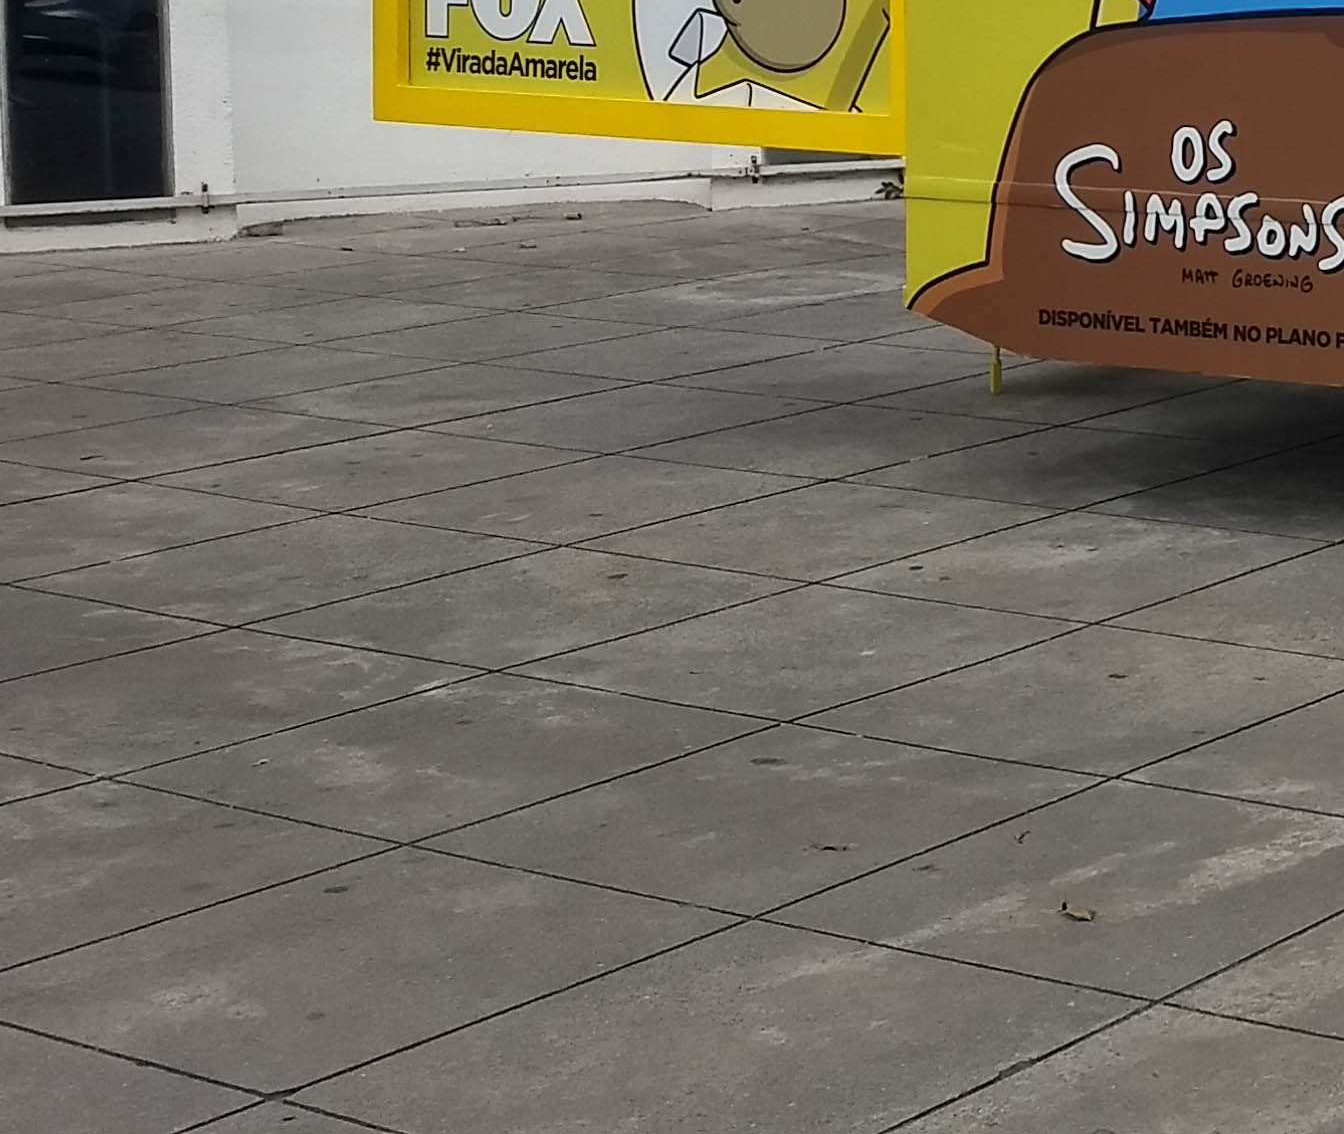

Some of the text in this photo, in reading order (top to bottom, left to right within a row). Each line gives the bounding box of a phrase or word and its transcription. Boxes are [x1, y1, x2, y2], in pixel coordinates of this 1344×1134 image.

[426, 47, 597, 81] #ViradaAmarela
[1170, 119, 1237, 184] OS
[1182, 268, 1313, 293] MATT GROENING
[1038, 309, 1145, 334] DISPONÍVEL
[1149, 317, 1228, 340] TAMBÉM
[1233, 325, 1261, 343] NO
[1266, 327, 1331, 348] PLANO
